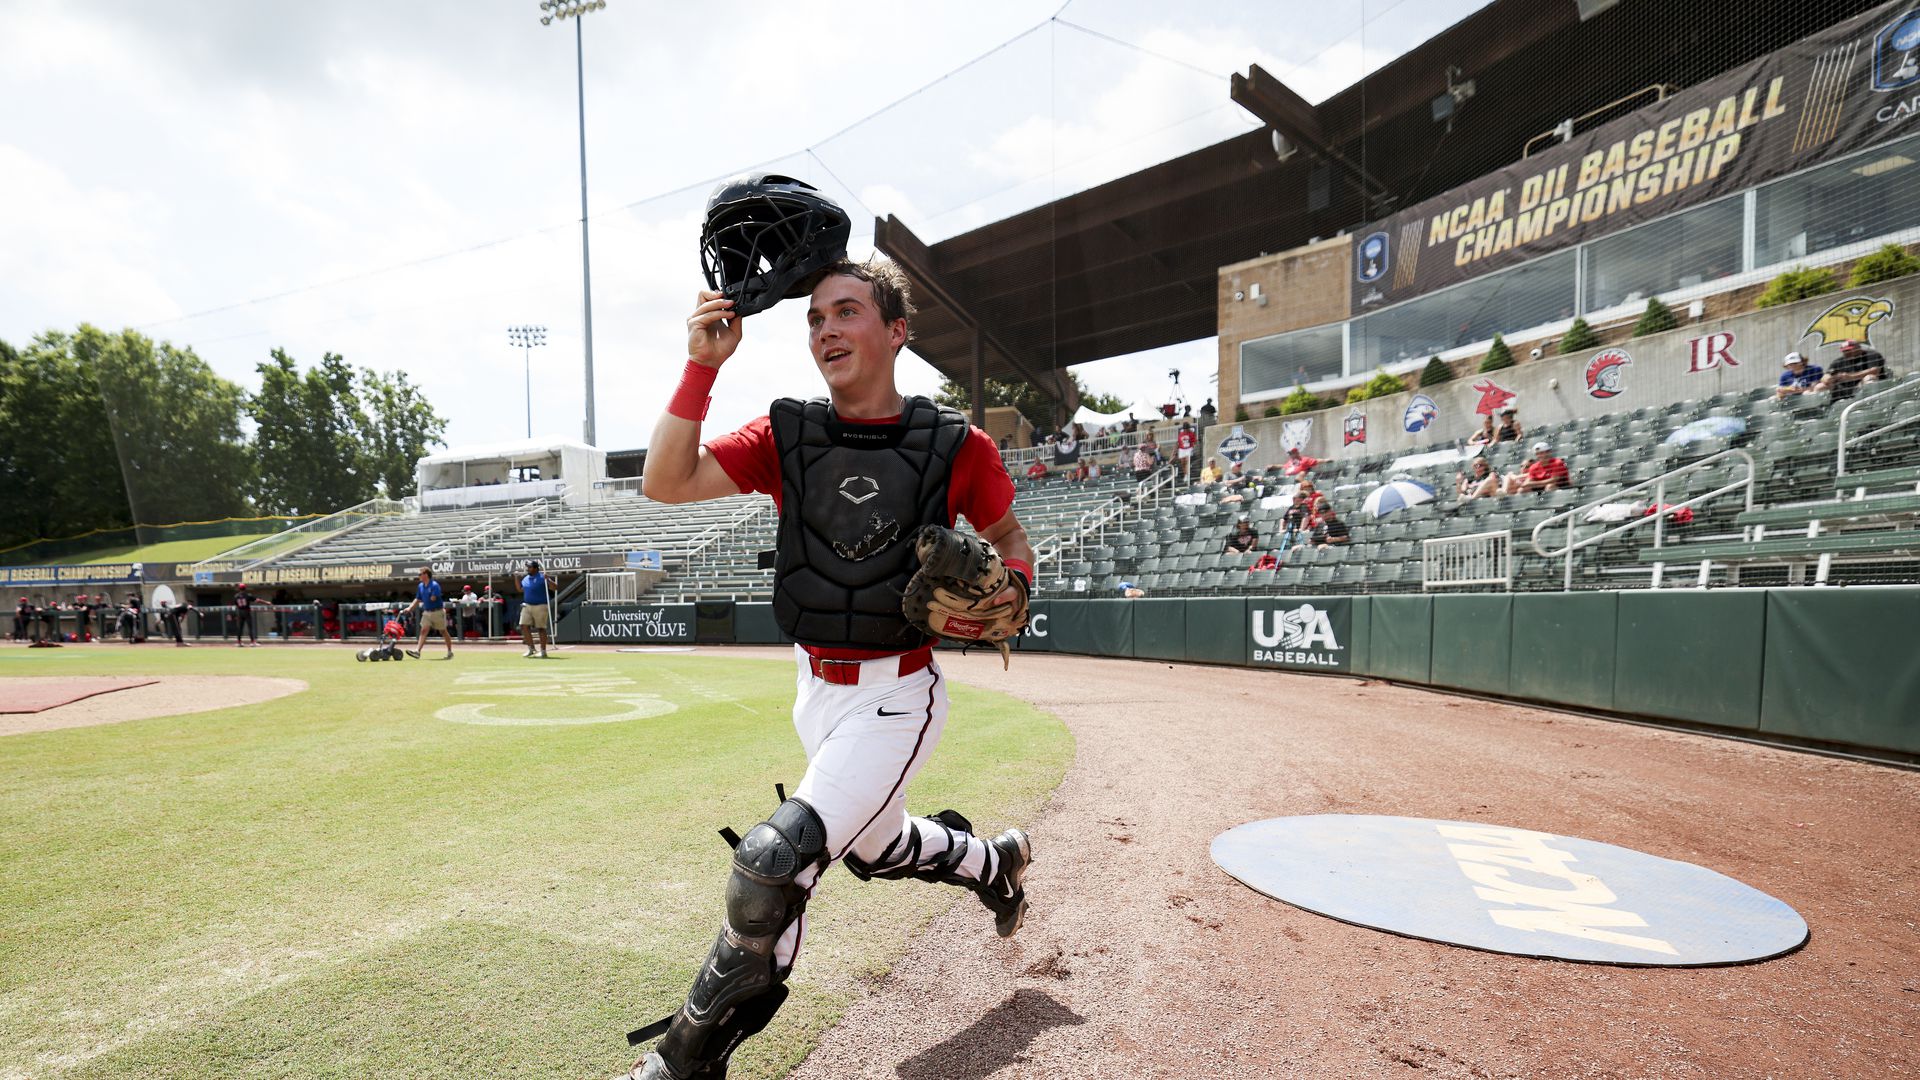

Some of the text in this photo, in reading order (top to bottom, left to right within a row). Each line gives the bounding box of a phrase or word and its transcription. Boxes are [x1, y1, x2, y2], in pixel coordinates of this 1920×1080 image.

[1519, 163, 1569, 213] DII
[1576, 76, 1786, 192] BASEBALL
[1454, 133, 1741, 267] CHAMPIONSHIP
[279, 567, 321, 582] BASEBALL
[322, 564, 393, 581] CHAMPIONSHIP
[431, 562, 455, 572] CARY
[467, 561, 504, 573] University
[505, 559, 514, 573] of
[553, 556, 582, 569] OLIVE
[602, 608, 665, 624] University of
[590, 621, 687, 637] MOUNT OLIVE
[1252, 604, 1339, 650] USA
[1253, 650, 1339, 666] BASEBALL
